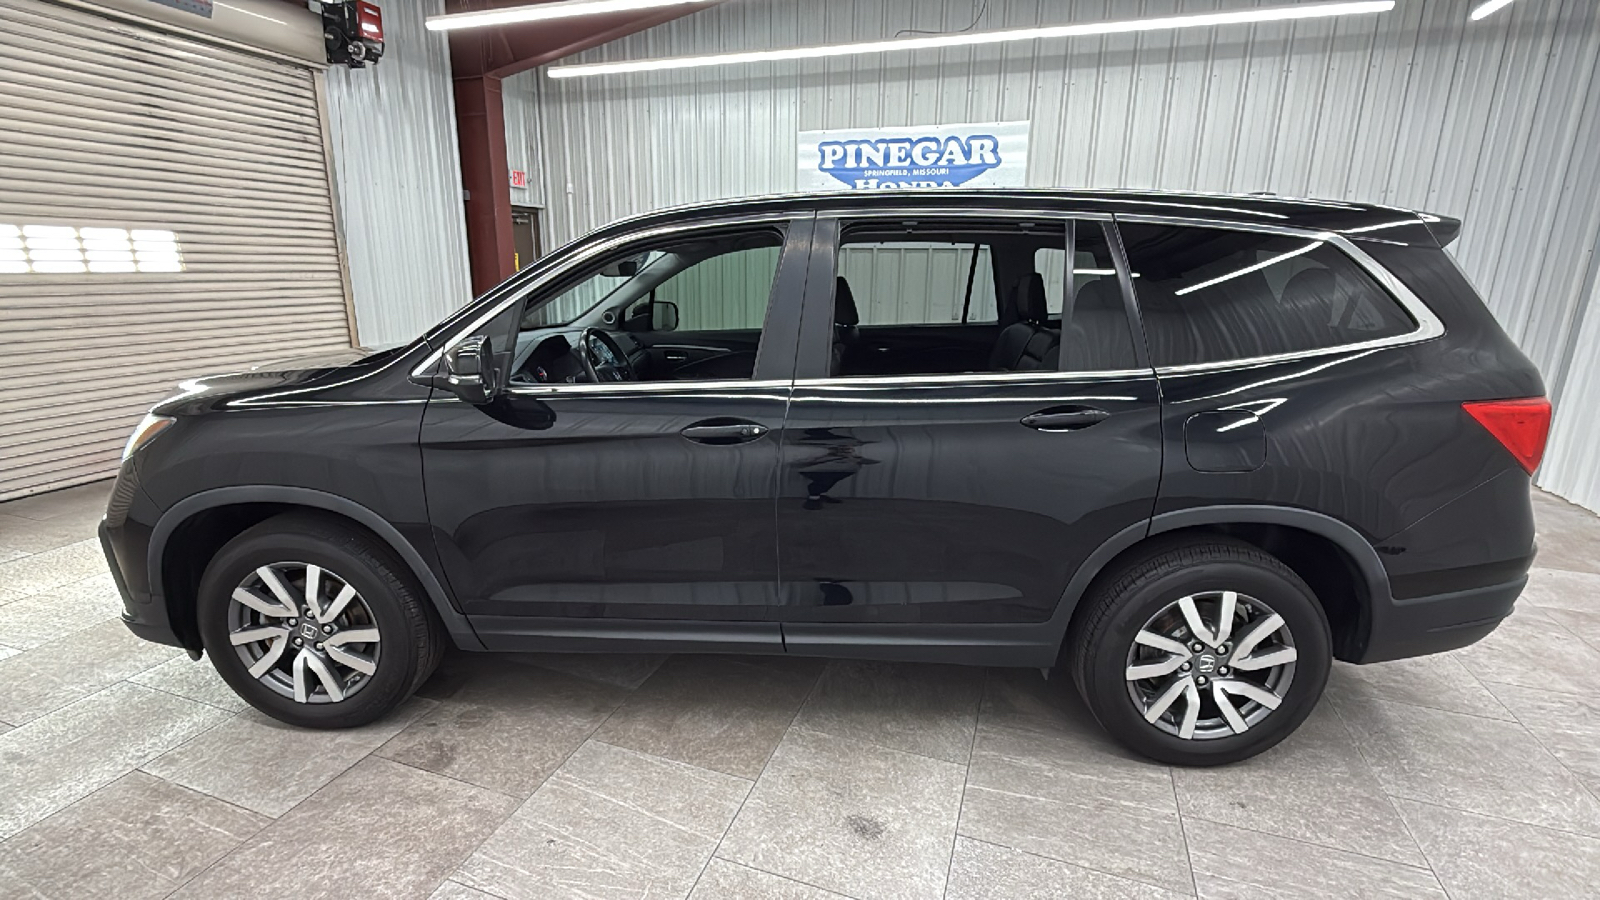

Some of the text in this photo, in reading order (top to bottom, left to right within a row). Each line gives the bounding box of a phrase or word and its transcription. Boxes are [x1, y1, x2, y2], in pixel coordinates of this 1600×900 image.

[821, 139, 997, 169] PINEGAR
[512, 170, 525, 187] EXIT
[864, 168, 949, 177] SPRINGFIELD, MISSOURI
